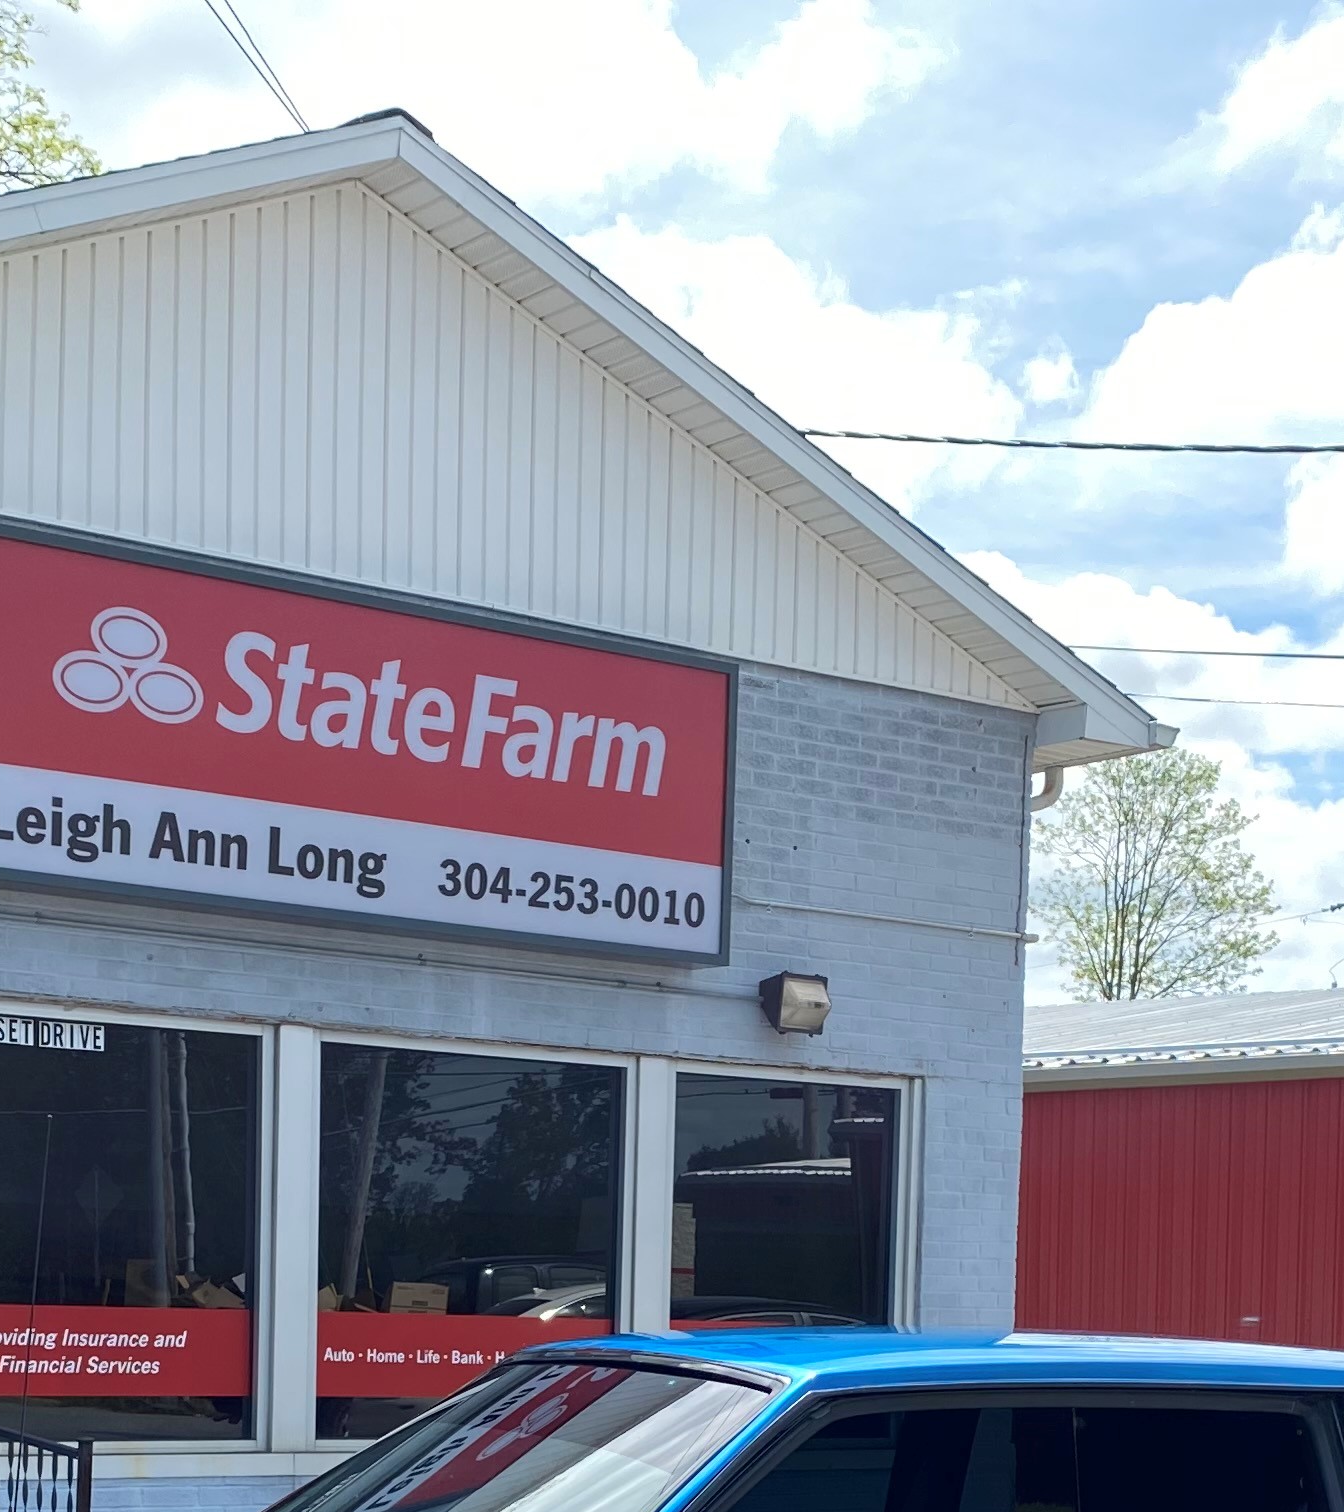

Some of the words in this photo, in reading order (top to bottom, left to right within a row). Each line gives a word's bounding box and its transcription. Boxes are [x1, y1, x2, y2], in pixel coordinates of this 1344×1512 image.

[150, 811, 248, 871] Ann
[268, 827, 387, 898] Long
[438, 858, 705, 929] 304-253-0010
[41, 1022, 102, 1050] DRIVE
[61, 1328, 149, 1348] Insurance
[154, 1330, 188, 1348] and
[86, 1356, 160, 1374] Services
[323, 1347, 355, 1362] Auto
[367, 1348, 405, 1363] Home
[417, 1350, 440, 1364] Life
[451, 1350, 484, 1365] Bank
